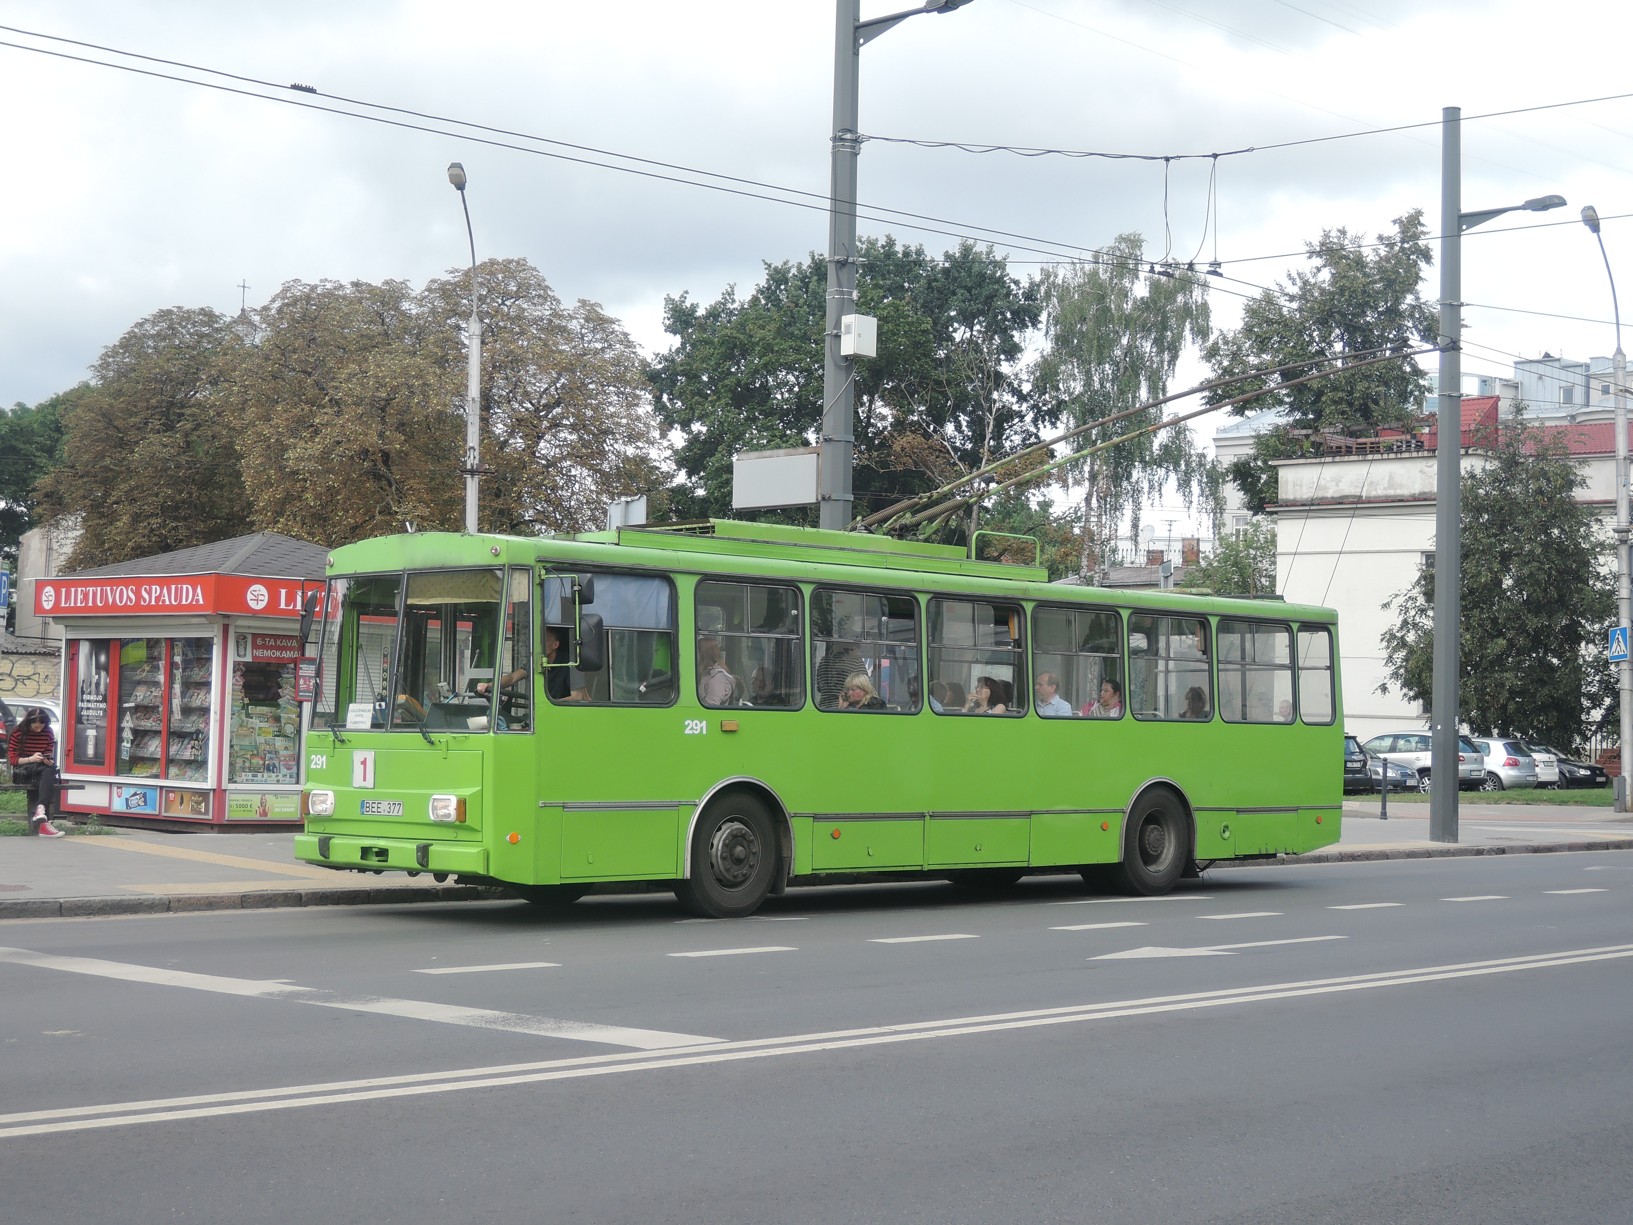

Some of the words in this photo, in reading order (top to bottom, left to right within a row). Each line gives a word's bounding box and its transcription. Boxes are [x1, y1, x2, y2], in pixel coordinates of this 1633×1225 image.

[60, 585, 136, 607] LIETUVOS
[140, 584, 205, 606] SPAUDA
[256, 637, 276, 646] 6-TA
[276, 638, 298, 647] KAVA
[684, 719, 707, 735] 291
[310, 754, 327, 769] 291
[360, 757, 368, 782] 1
[365, 801, 383, 814] BEE
[386, 803, 402, 815] 377
